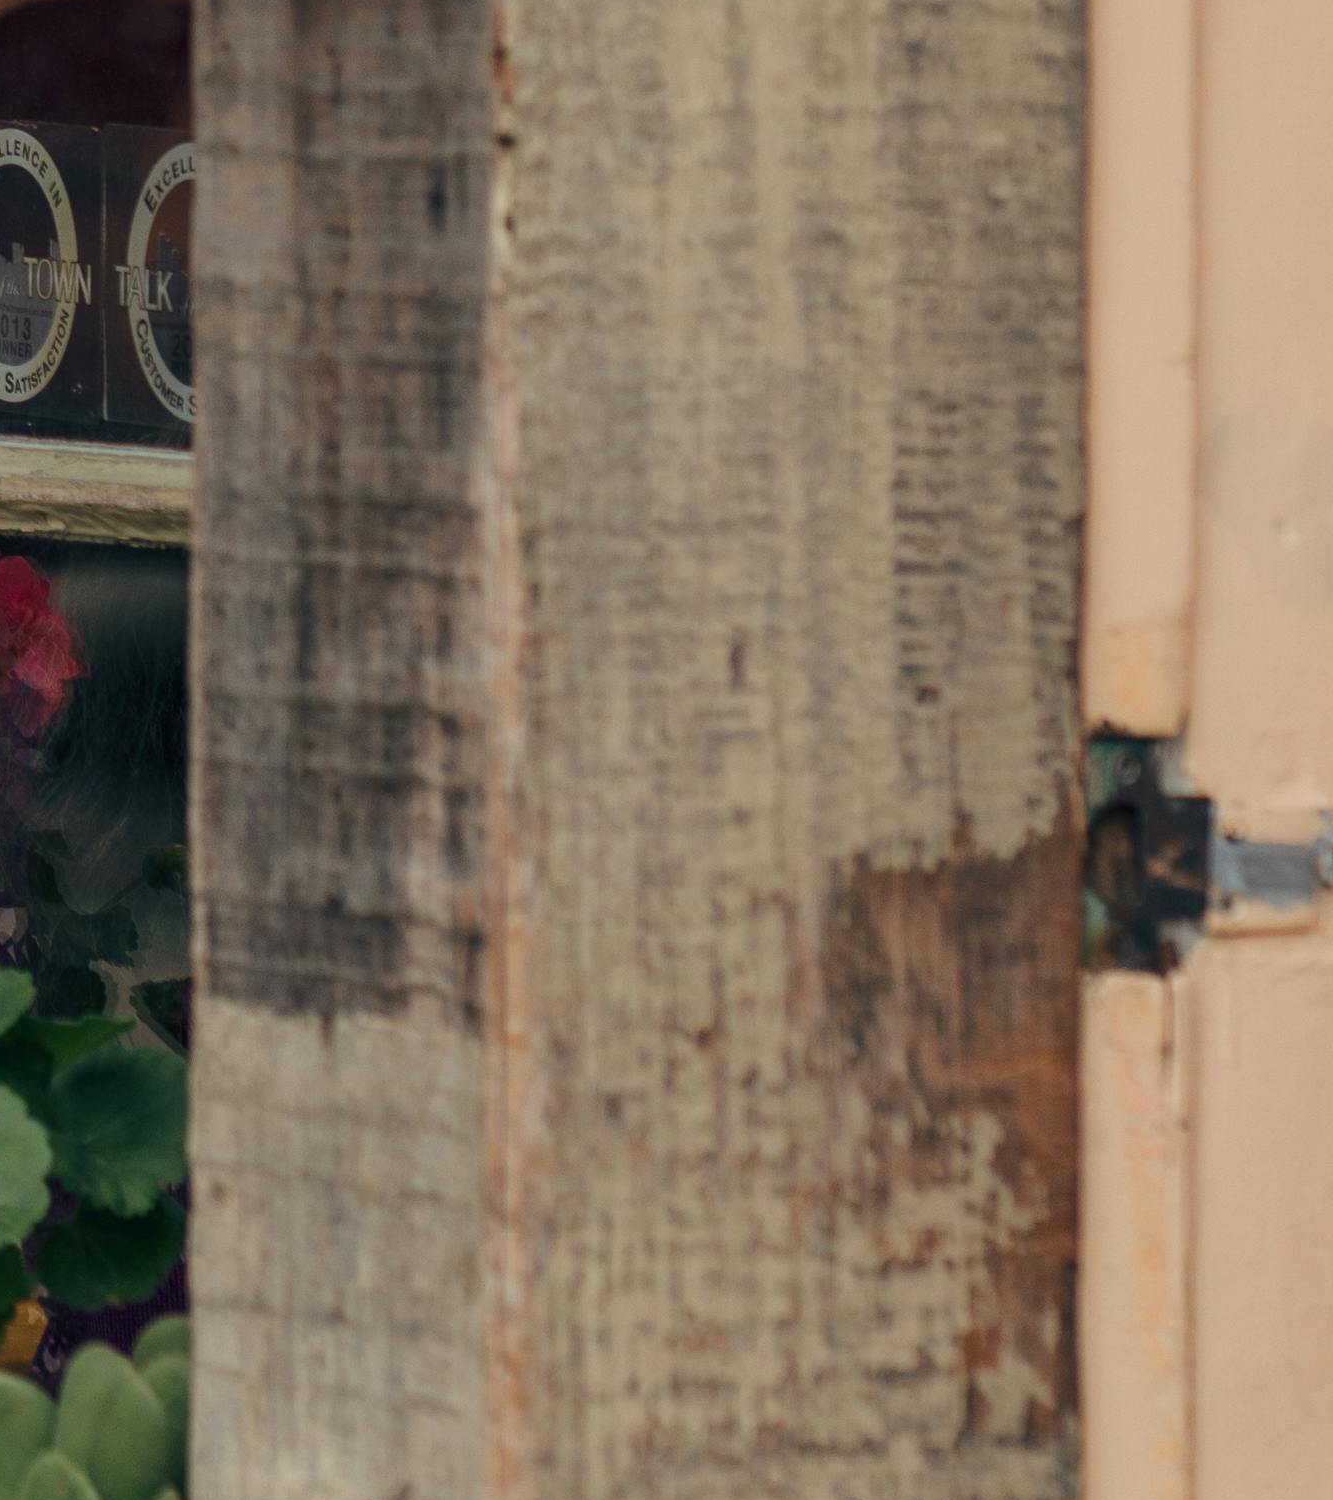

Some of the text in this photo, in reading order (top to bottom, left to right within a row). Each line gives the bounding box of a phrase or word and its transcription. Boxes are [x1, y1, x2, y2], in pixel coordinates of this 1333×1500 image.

[49, 181, 62, 208] IN
[144, 155, 196, 216] EXCELL
[23, 256, 92, 305] TOWN
[114, 264, 174, 312] TALK
[4, 308, 70, 394] SATISFACTION
[136, 319, 185, 412] CUSTOMER
